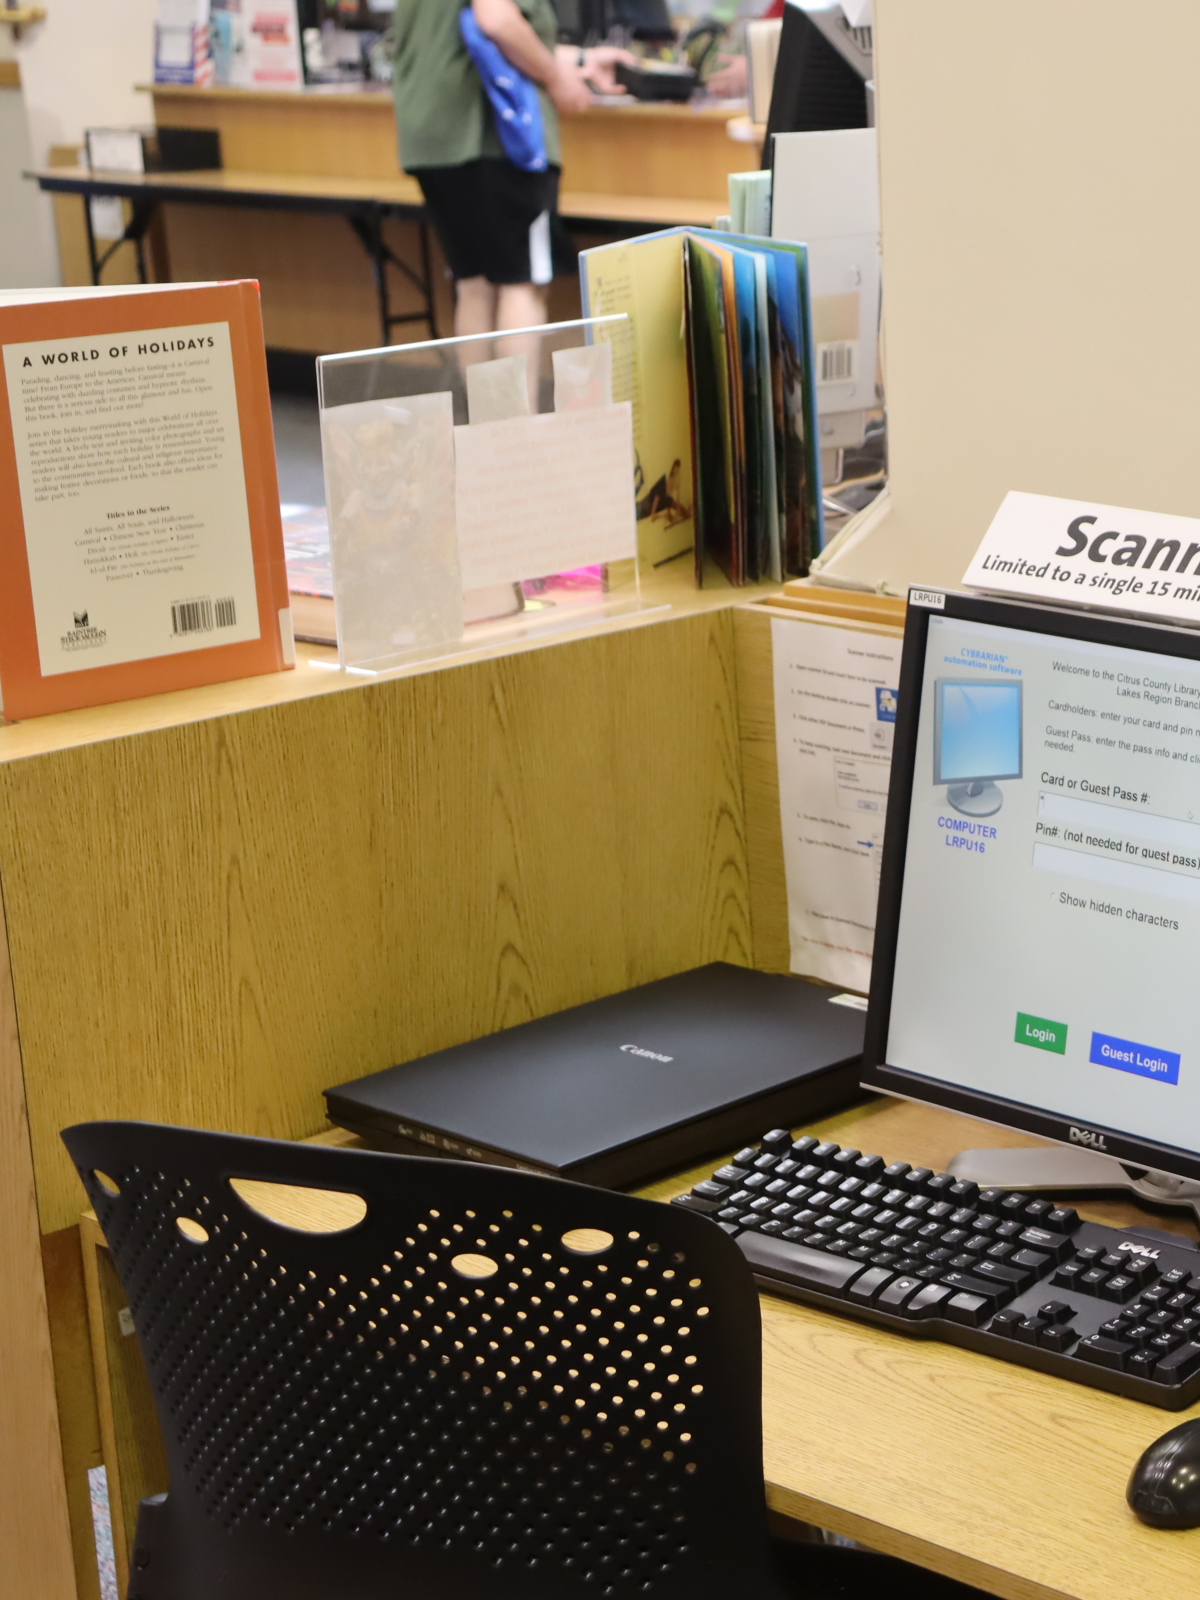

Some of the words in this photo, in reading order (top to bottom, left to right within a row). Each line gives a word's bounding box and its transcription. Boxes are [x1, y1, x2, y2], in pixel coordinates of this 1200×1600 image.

[21, 356, 32, 367] A
[41, 349, 100, 365] WORLD
[108, 346, 128, 358] OF
[137, 336, 214, 355] HOLIDAYS
[982, 554, 1049, 578] Limited
[1051, 566, 1071, 582] to
[1074, 573, 1085, 585] a
[1089, 572, 1143, 596] single
[1146, 579, 1169, 596] 15
[914, 591, 942, 604] LRPU16
[944, 656, 987, 669] automation
[990, 663, 1022, 676] software
[1053, 661, 1090, 678] Welcome
[1093, 669, 1099, 678] to
[1102, 670, 1115, 681] the
[1117, 673, 1140, 686] Citrus
[1143, 678, 1171, 692] County
[1117, 686, 1140, 699] Lakes
[1143, 691, 1172, 705] Region
[1048, 700, 1098, 718] Cardholders:
[1100, 710, 1120, 722] enter
[1123, 714, 1140, 727] your
[1143, 716, 1160, 729] card
[1163, 720, 1178, 733] and
[1180, 724, 1193, 736] pin
[1044, 740, 1075, 753] needed.
[1046, 726, 1069, 740] Guest
[1071, 730, 1093, 743] Pass:
[1096, 736, 1116, 748] enter
[1118, 739, 1131, 750] the
[1133, 743, 1152, 755] pass
[1155, 746, 1170, 758] info
[1172, 749, 1187, 762] and
[1041, 772, 1065, 787] Card
[1067, 780, 1077, 789] or
[1080, 780, 1110, 797] Guest
[1113, 786, 1138, 802] Pass
[1141, 793, 1151, 805] #:
[938, 816, 997, 839] COMPUTER
[946, 834, 985, 853] LRPU16
[1036, 823, 1060, 838] Pin#:
[1064, 828, 1083, 843] (not
[1086, 835, 1122, 851] needed
[1125, 842, 1139, 855] for
[1173, 854, 1200, 870] pass)
[1060, 892, 1087, 908] Show
[1090, 899, 1123, 917] hidden
[1126, 909, 1178, 930] characters
[1026, 1024, 1056, 1042] Login
[620, 1045, 673, 1063] Canon
[1101, 1044, 1134, 1063] Guest
[1136, 1053, 1168, 1073] Login
[1070, 1127, 1107, 1150] DELL
[1118, 1241, 1161, 1260] DELL
